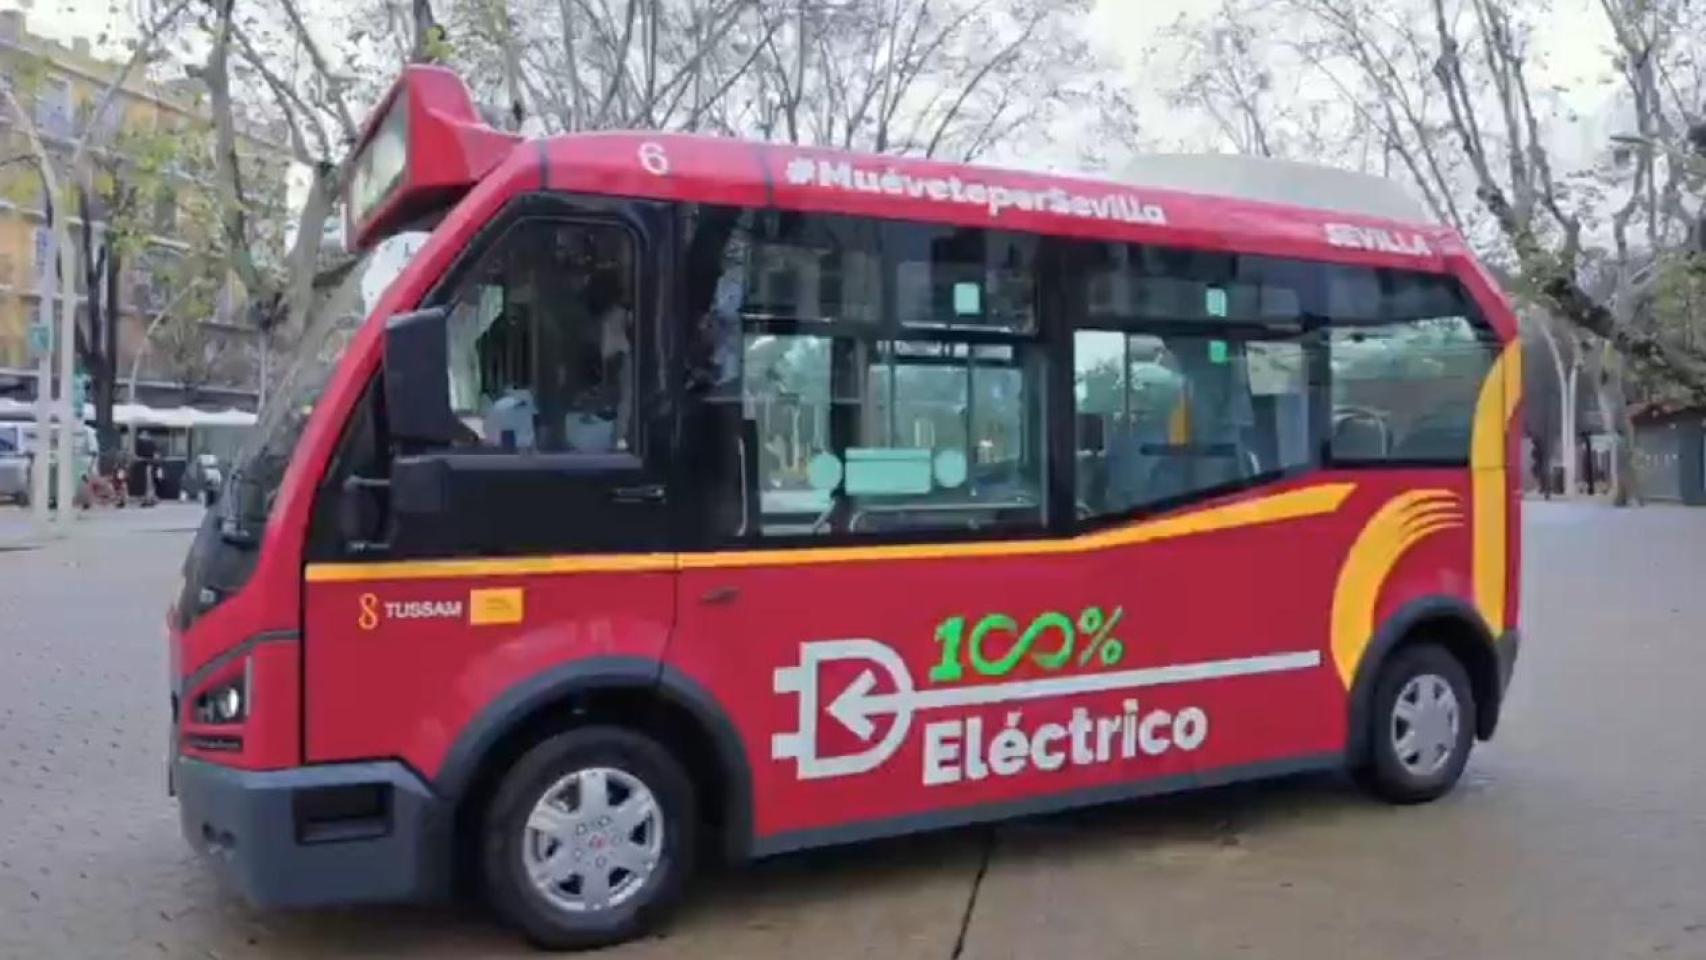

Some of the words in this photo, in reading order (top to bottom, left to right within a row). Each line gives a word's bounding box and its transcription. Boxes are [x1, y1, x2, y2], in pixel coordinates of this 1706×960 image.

[638, 142, 669, 176] 6
[1324, 222, 1433, 257] SEVILLA
[385, 601, 463, 619] TUSSAM
[929, 605, 1124, 682] 100%
[922, 699, 1209, 787] Eléctrico
